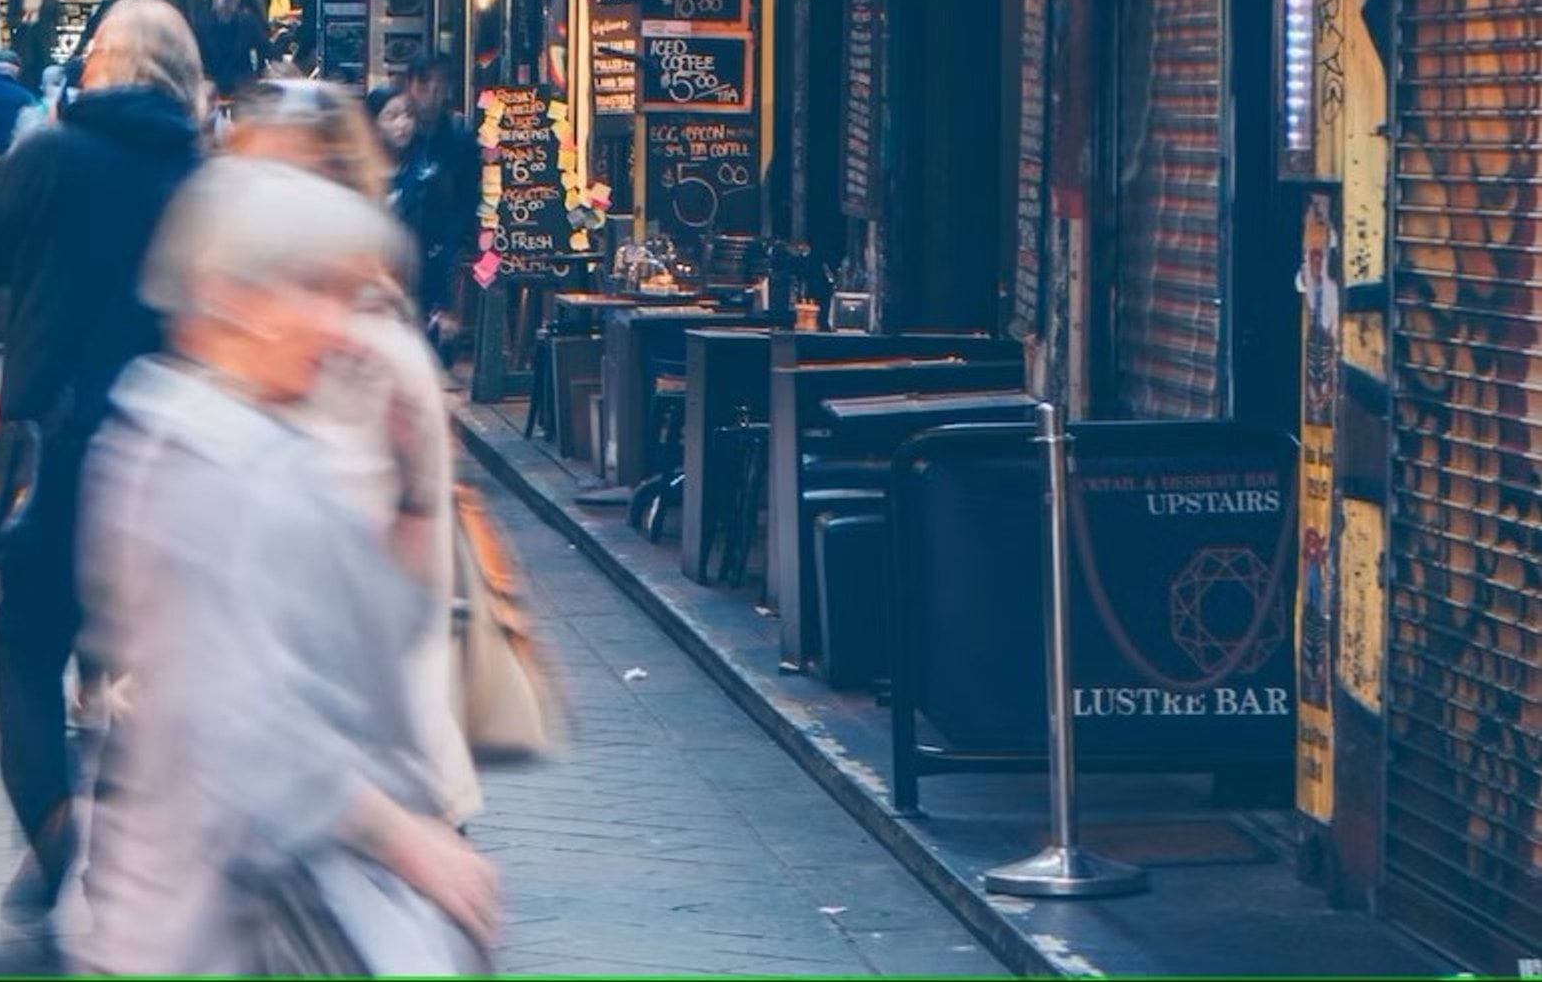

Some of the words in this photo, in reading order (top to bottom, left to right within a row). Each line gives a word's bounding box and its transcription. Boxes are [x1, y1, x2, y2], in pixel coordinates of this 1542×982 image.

[661, 55, 716, 70] COFFEE
[511, 231, 553, 250] FRESH
[1146, 490, 1281, 515] UPSTAIRS
[1073, 688, 1207, 716] LUSTRE
[1215, 687, 1289, 716] BAR
